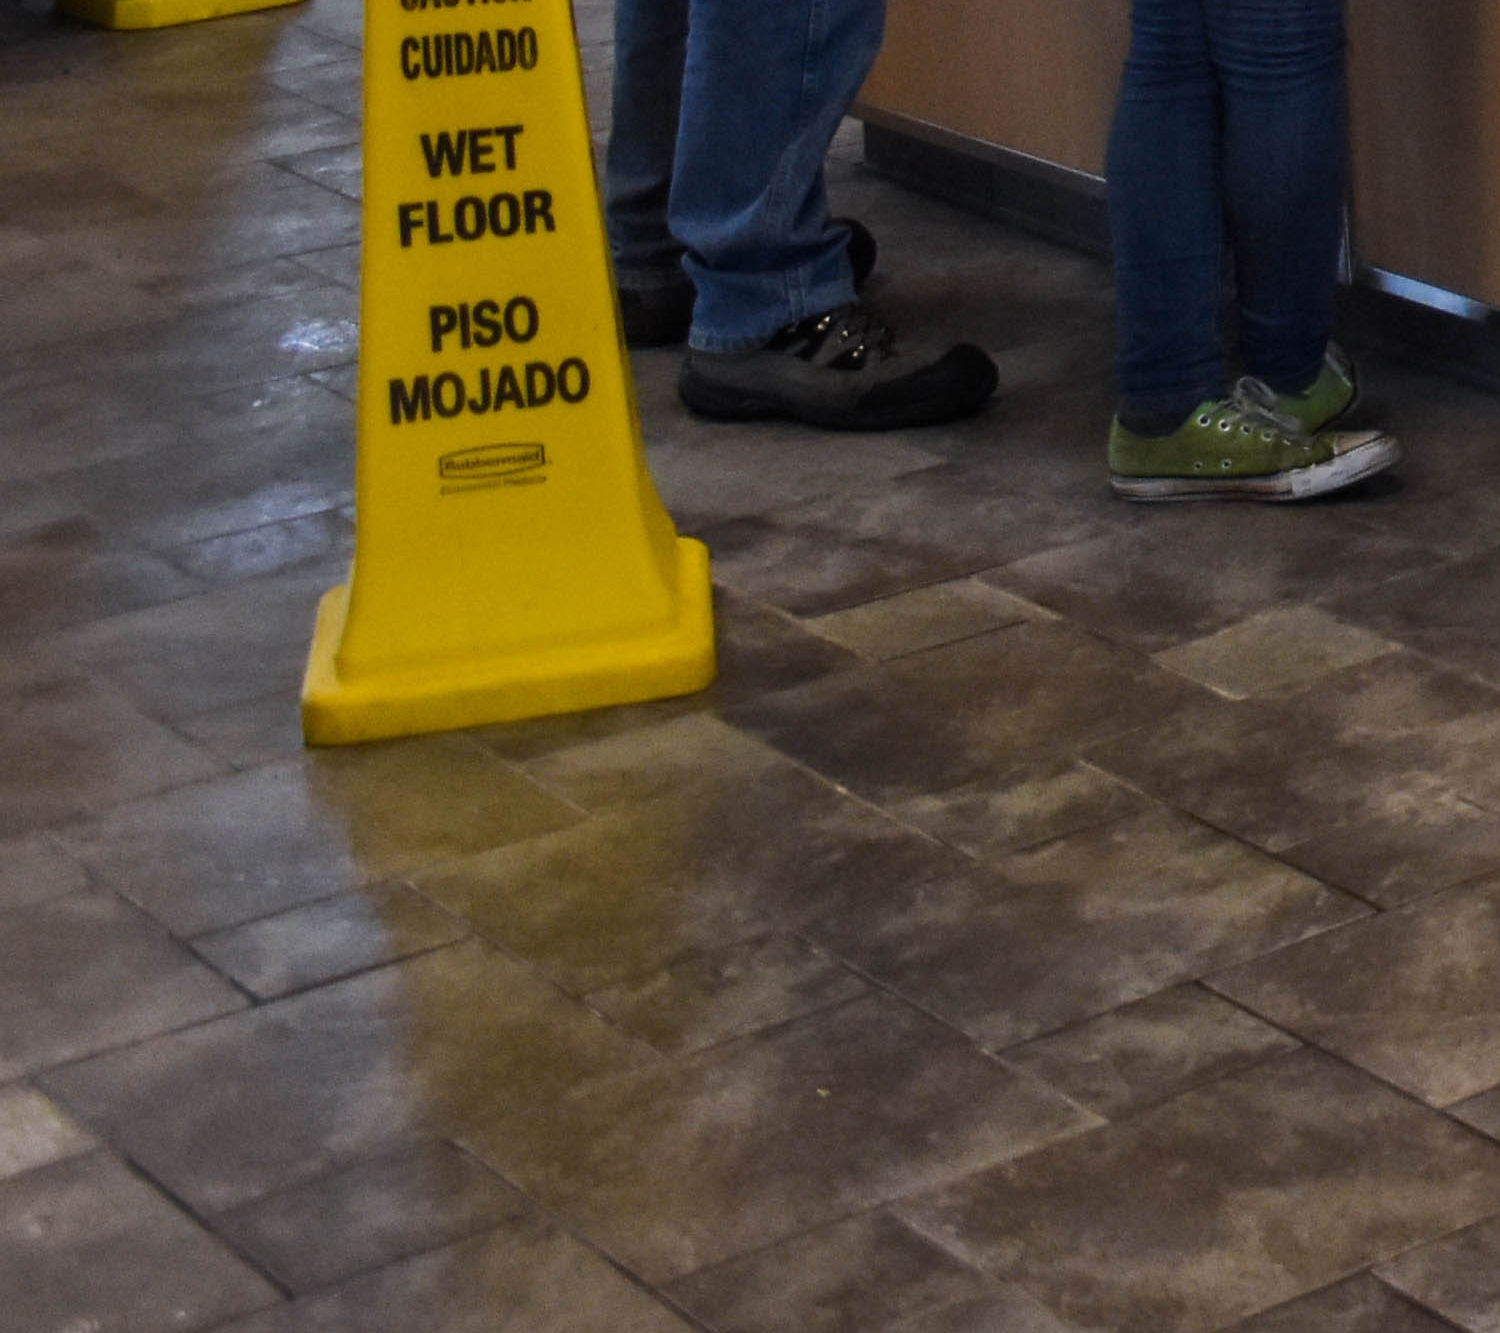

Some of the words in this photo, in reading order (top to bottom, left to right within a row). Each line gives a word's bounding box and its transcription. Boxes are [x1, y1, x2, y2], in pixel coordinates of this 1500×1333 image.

[400, 26, 538, 81] CUIDADO
[419, 125, 524, 178] WET
[398, 189, 556, 248] FLOOR
[428, 294, 540, 353] PISO
[389, 356, 590, 425] MOJADO
